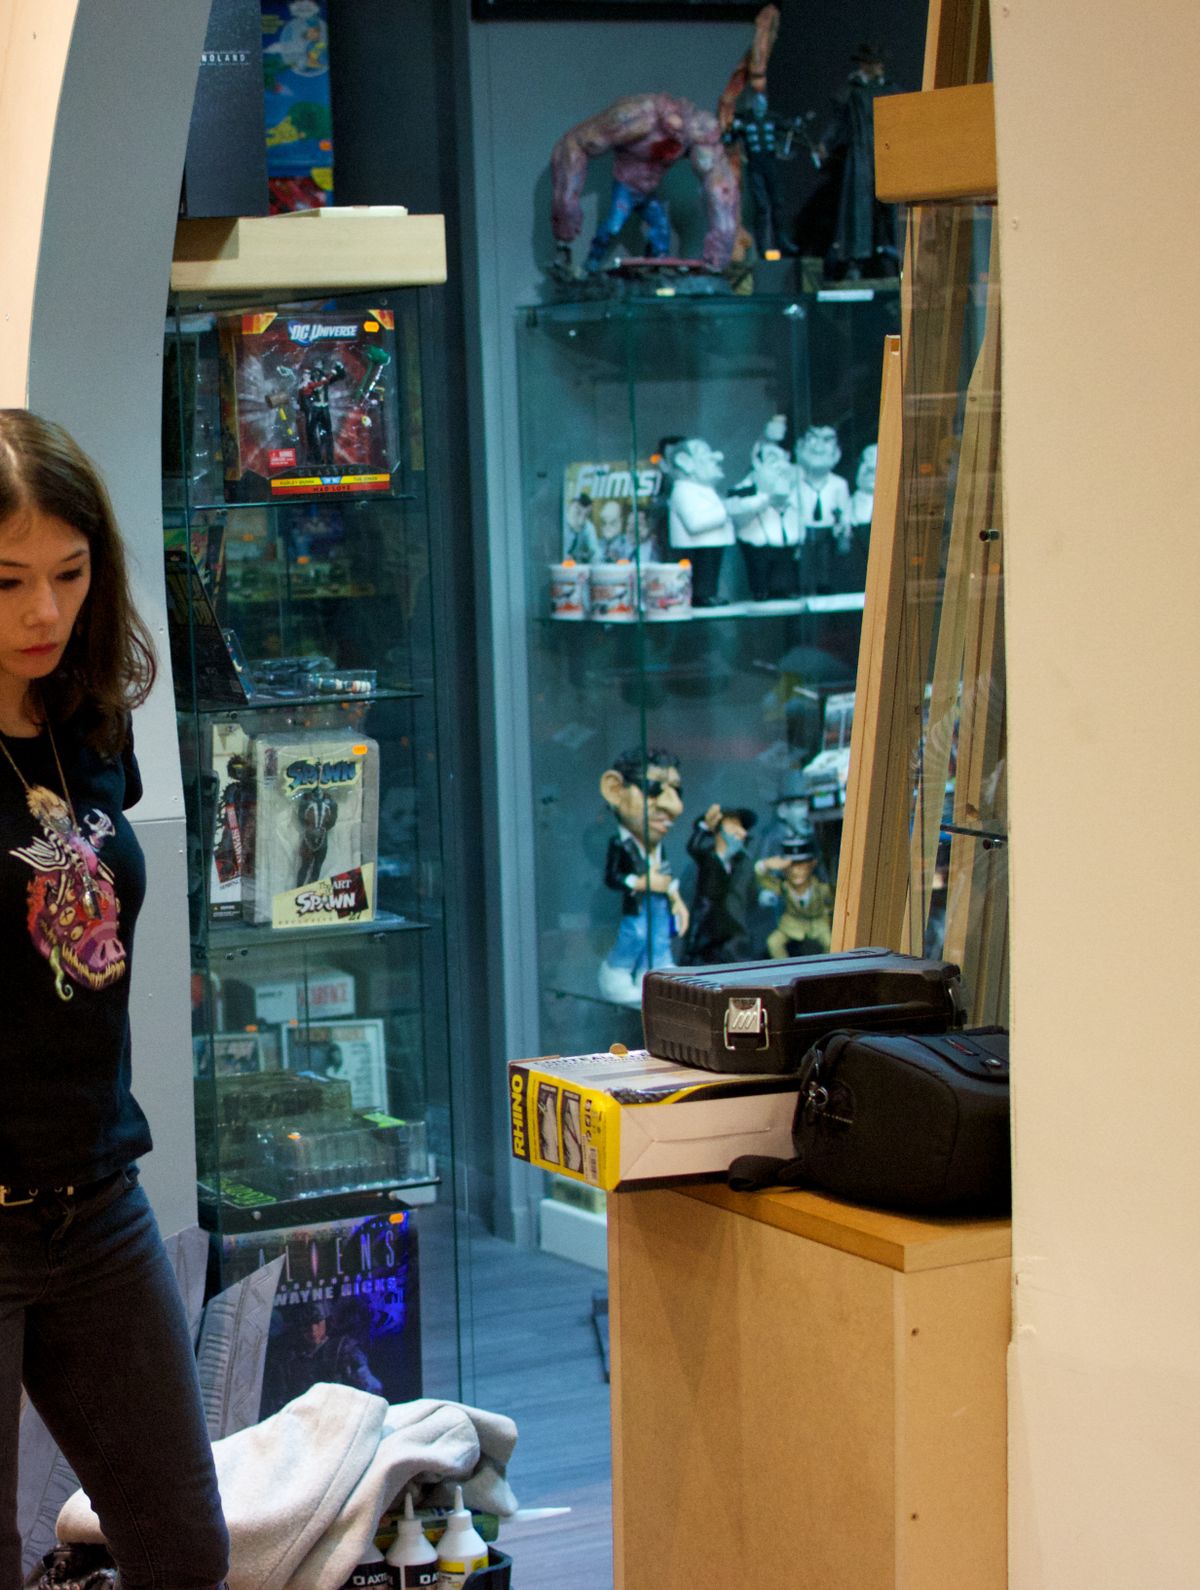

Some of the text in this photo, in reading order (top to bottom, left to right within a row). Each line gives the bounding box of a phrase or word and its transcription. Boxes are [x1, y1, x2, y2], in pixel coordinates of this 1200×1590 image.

[291, 324, 358, 340] DC UNIVERSE
[296, 893, 356, 915] SPAWN
[511, 1074, 525, 1157] RHINO
